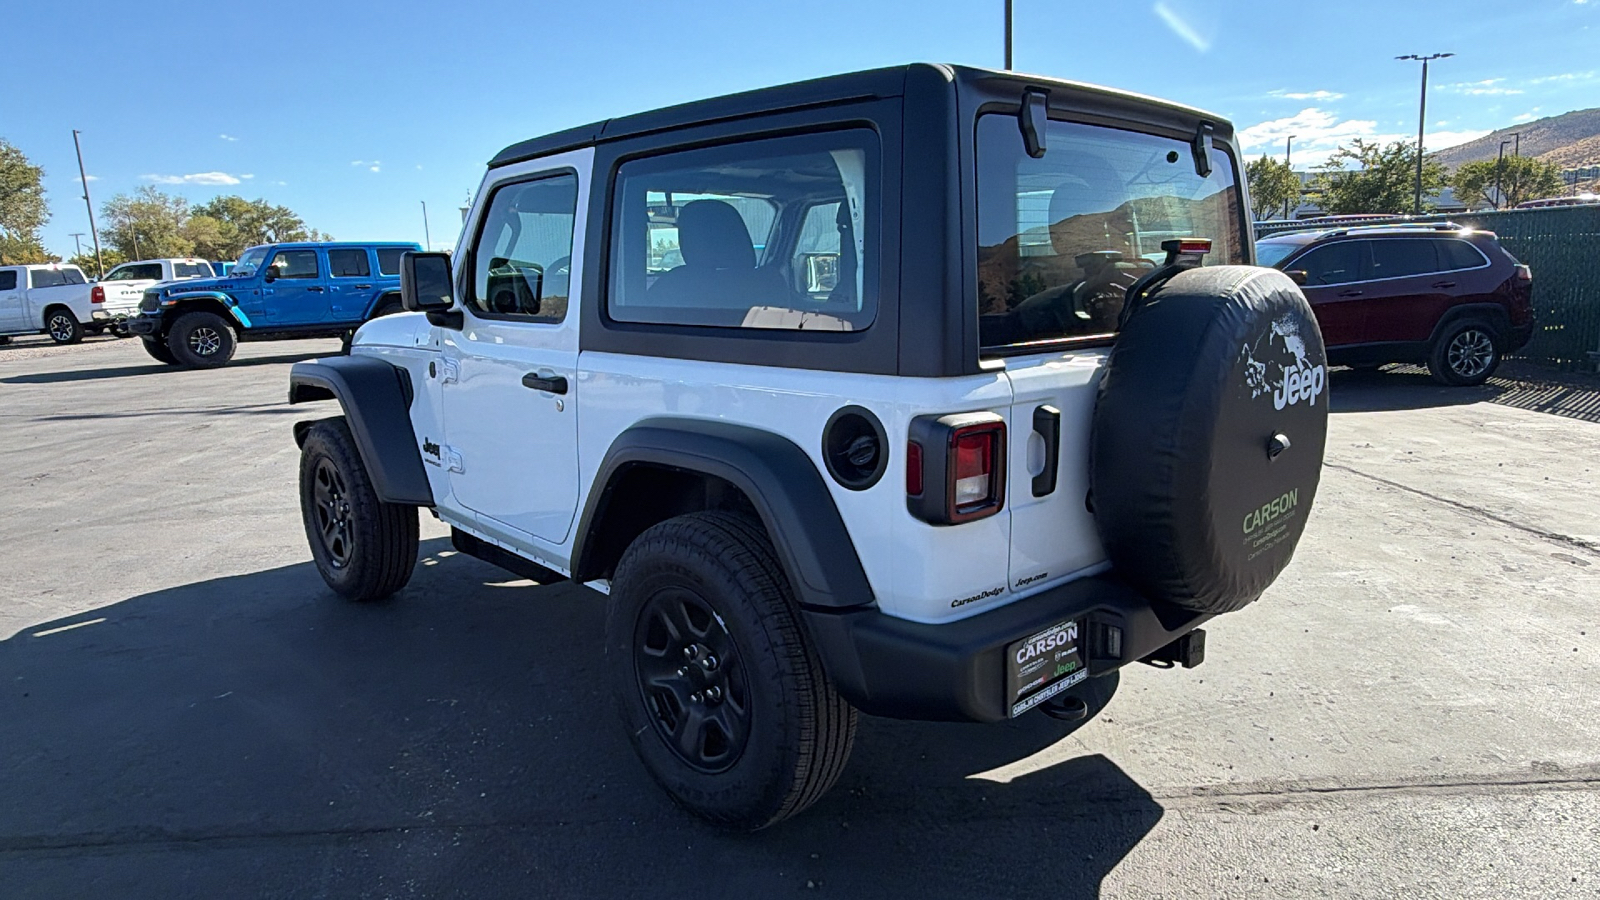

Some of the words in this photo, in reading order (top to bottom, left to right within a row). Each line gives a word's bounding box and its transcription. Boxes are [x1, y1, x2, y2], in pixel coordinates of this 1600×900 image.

[1274, 364, 1324, 411] Jeep
[423, 436, 441, 461] Jeep
[1243, 488, 1298, 534] CARSON
[951, 586, 1005, 608] CarsonDodge
[1015, 572, 1048, 587] Jeep.com
[1016, 625, 1078, 664] CARSON
[1054, 660, 1076, 677] Jeep
